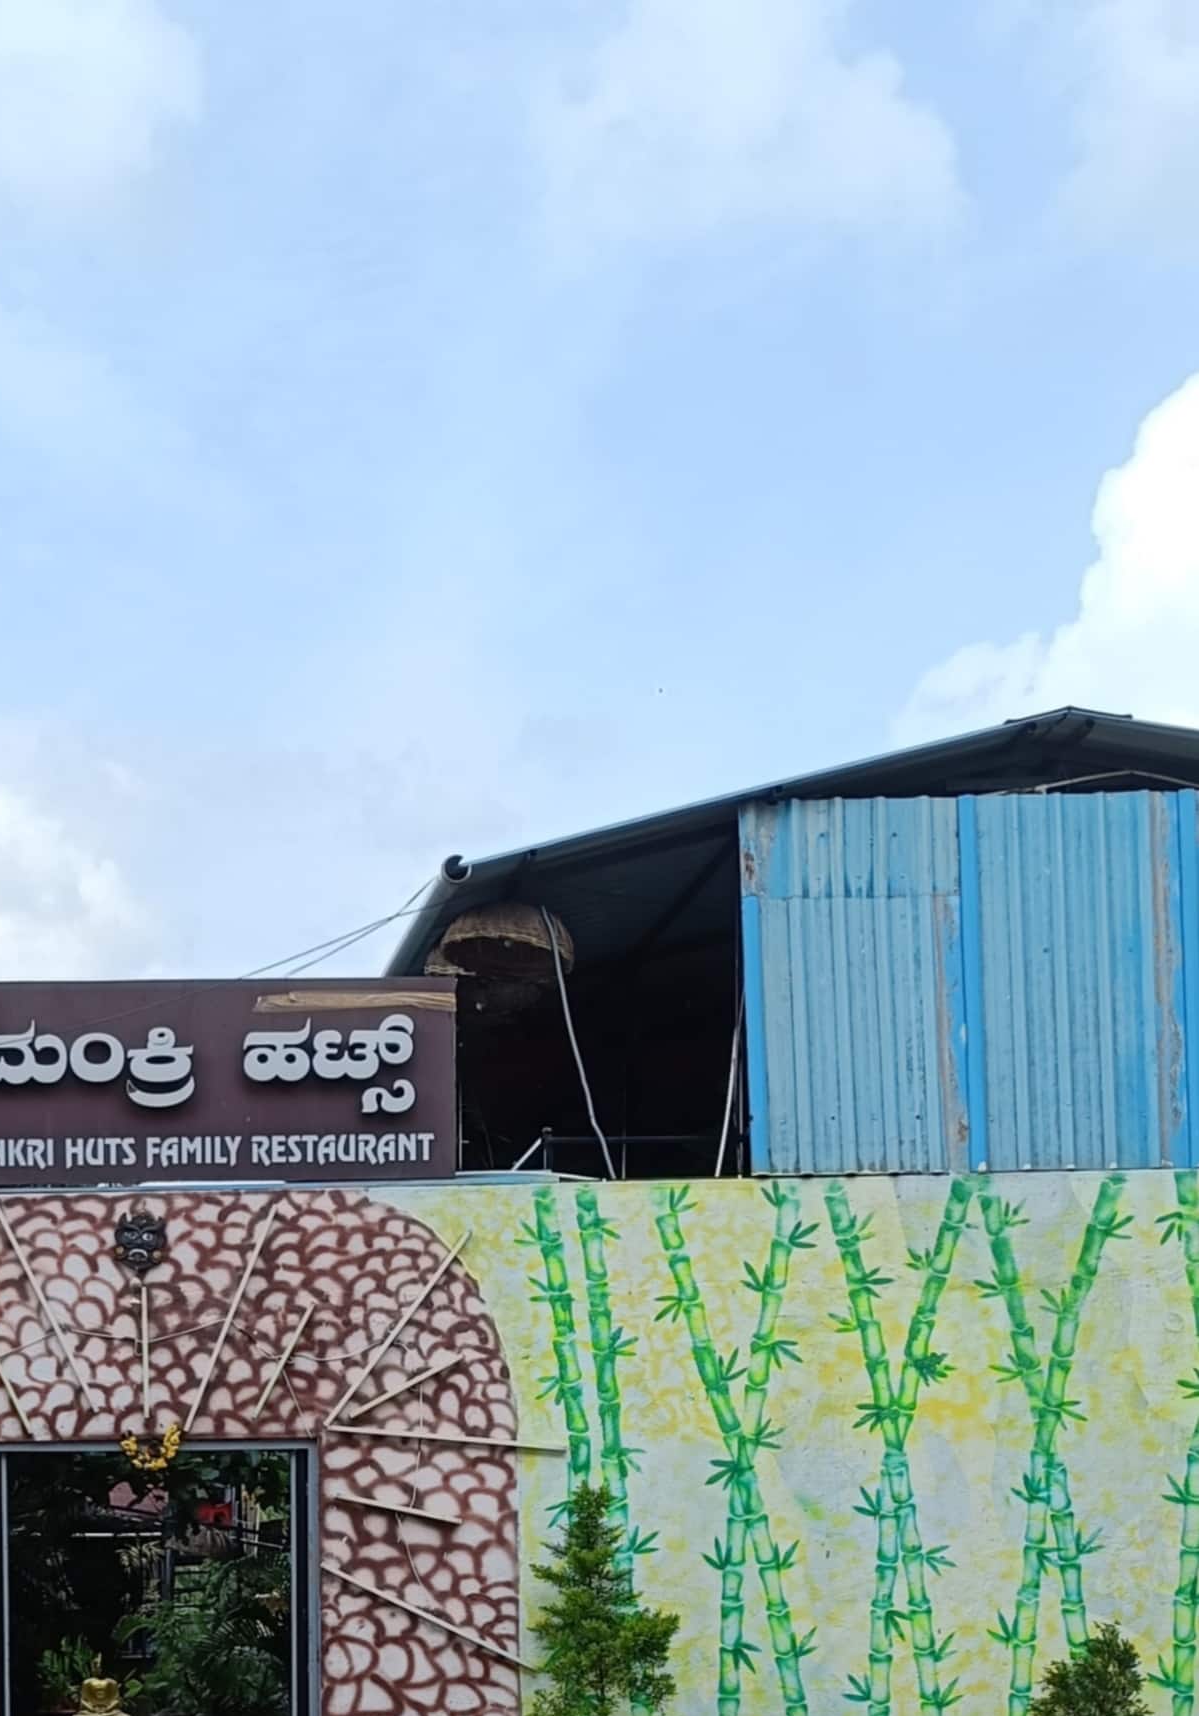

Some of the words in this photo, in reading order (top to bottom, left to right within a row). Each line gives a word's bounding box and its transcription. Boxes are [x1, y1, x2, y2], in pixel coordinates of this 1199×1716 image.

[242, 1013, 416, 1114] ಹಟ್ಸ್
[65, 1136, 137, 1168] HUTS
[146, 1135, 242, 1168] FAMILY
[250, 1132, 435, 1167] RESTAURANT
